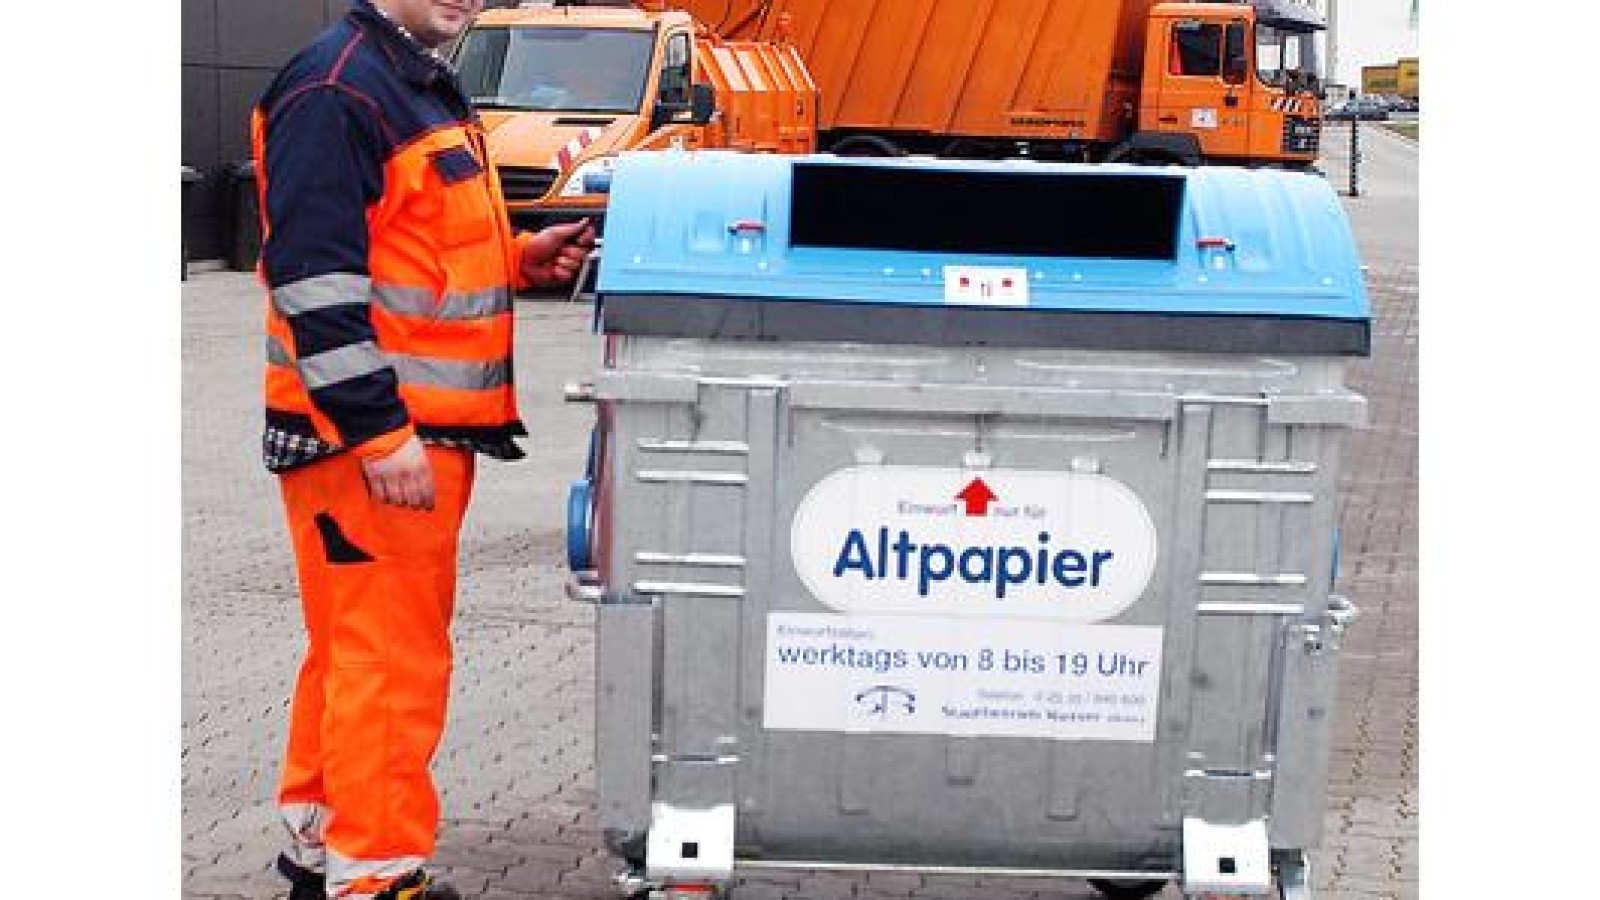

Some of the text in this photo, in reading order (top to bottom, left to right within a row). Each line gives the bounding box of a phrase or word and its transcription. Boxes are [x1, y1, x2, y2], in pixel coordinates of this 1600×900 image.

[833, 526, 1114, 599] Altpapier
[778, 641, 1150, 676] werktags von 8 bis 19 Uhr
